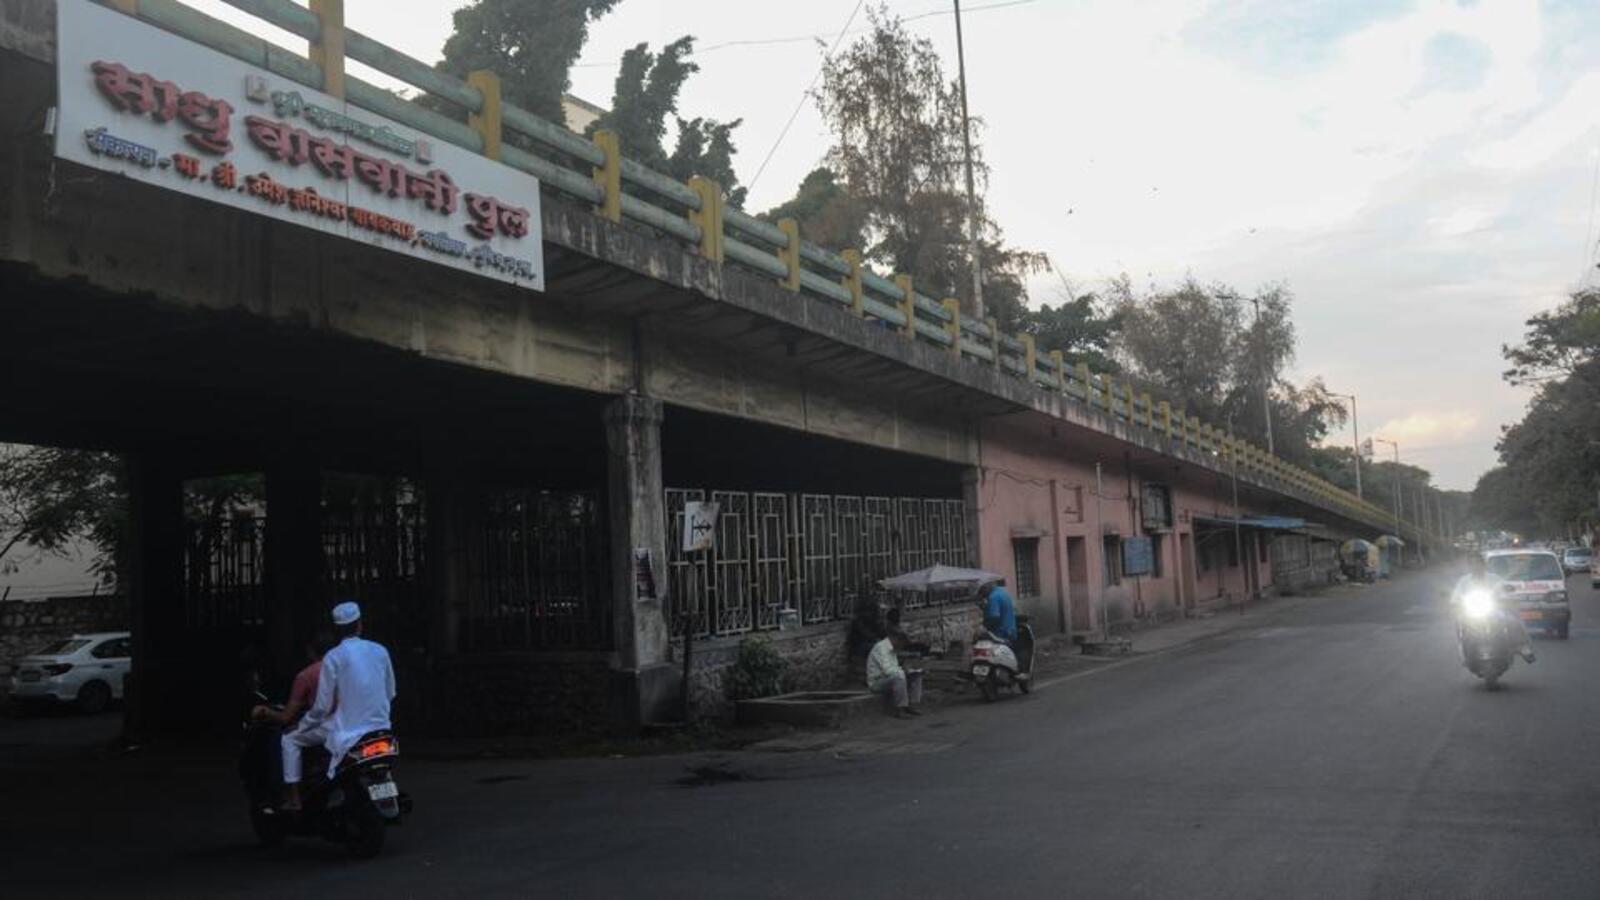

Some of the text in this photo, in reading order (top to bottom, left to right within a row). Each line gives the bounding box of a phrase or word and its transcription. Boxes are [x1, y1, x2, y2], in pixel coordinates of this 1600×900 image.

[91, 60, 529, 241] साधु वासवानी पुल
